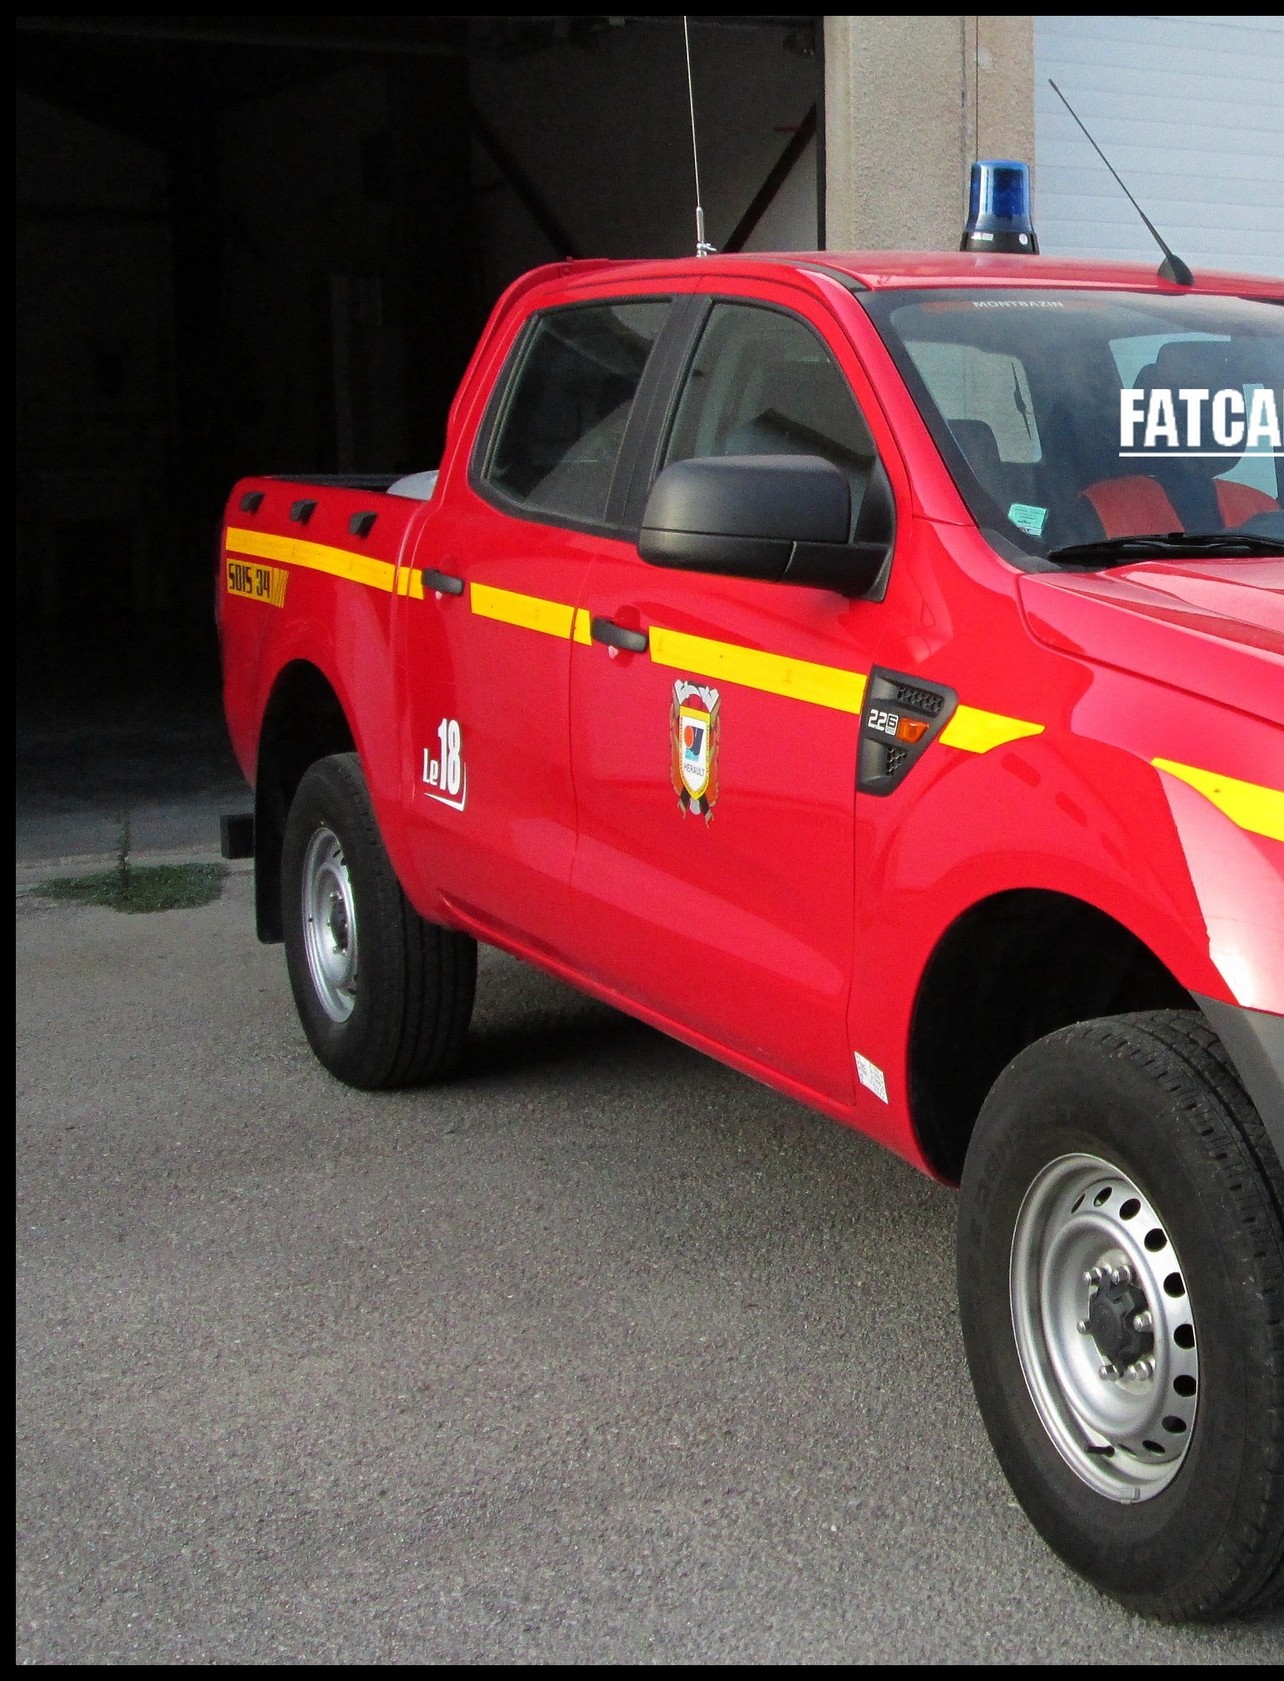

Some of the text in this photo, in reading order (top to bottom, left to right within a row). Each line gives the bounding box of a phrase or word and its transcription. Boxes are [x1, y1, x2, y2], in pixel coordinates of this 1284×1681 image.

[255, 568, 270, 599] 34
[422, 717, 461, 796] Le 18
